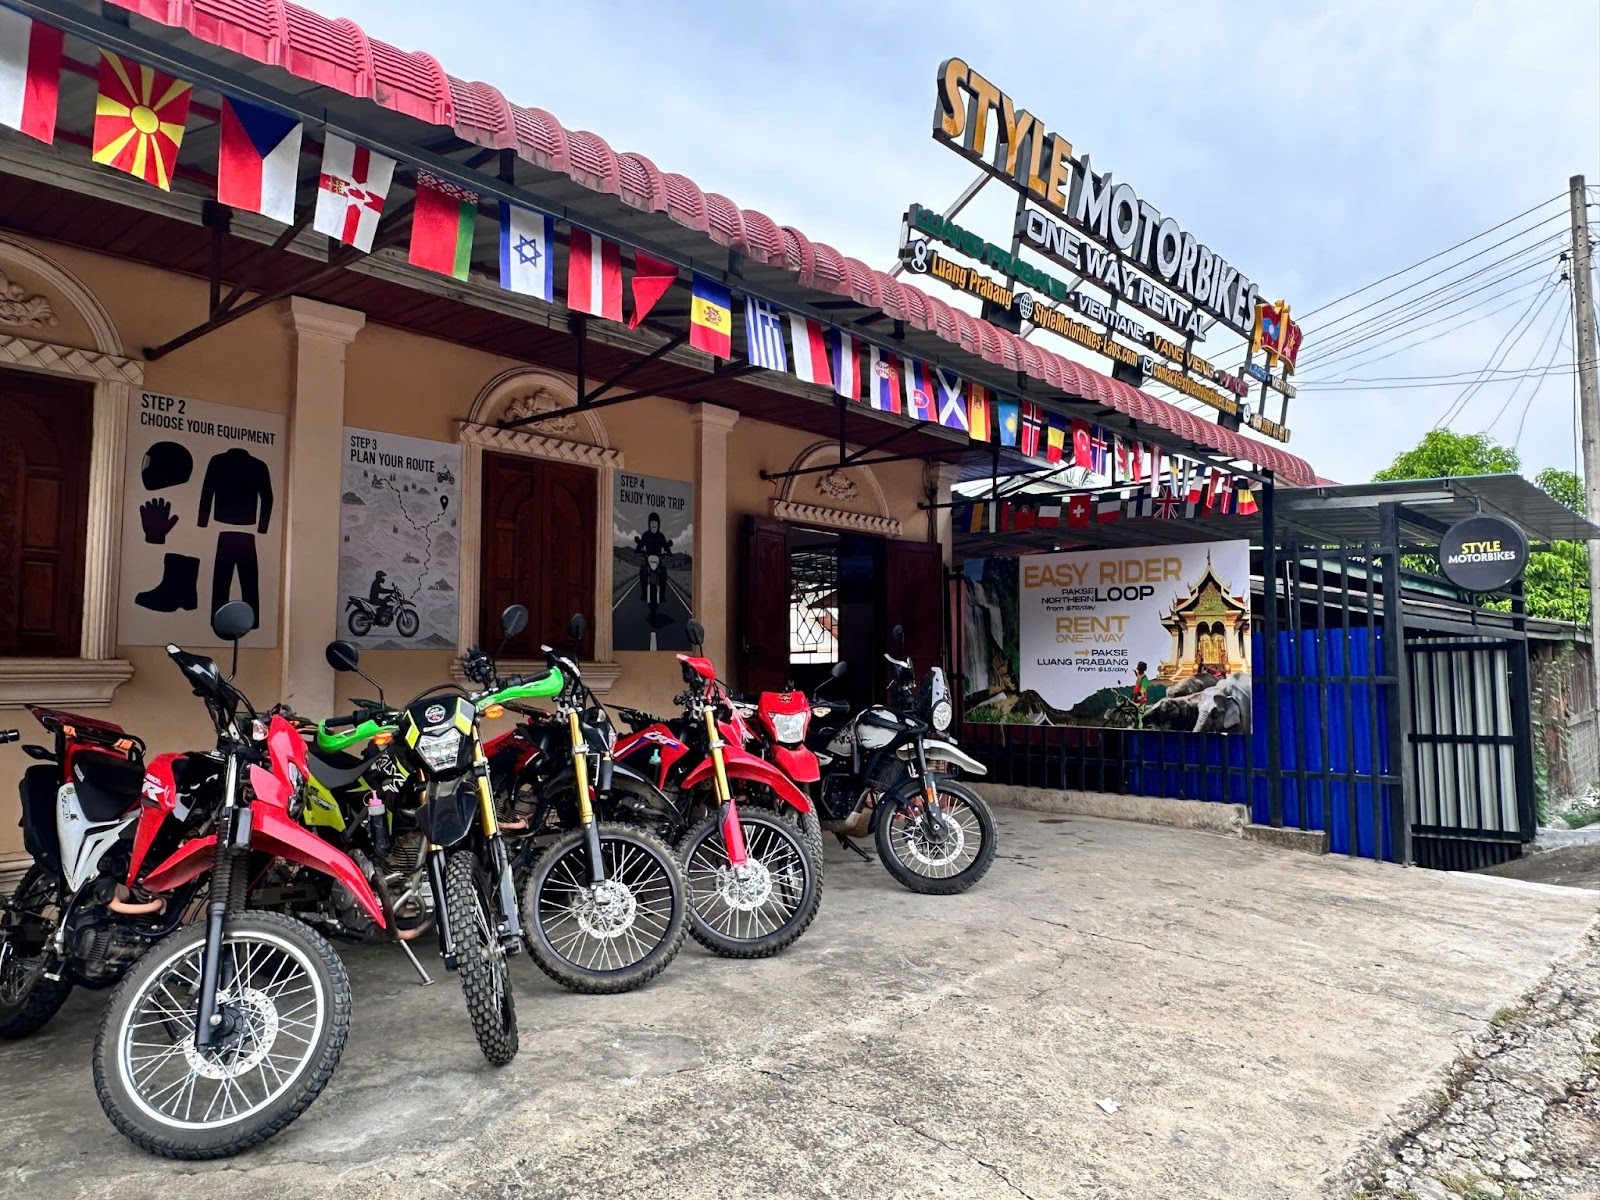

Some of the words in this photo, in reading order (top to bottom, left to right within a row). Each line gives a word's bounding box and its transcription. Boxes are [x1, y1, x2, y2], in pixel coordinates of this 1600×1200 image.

[936, 57, 1073, 211] STYLE
[1076, 157, 1258, 332] MOTORBIKES
[932, 252, 968, 290] Luang
[969, 270, 1013, 310] Prabang
[1026, 209, 1081, 265] ONE
[1086, 244, 1136, 300] WAY
[1139, 278, 1207, 341] RENTAL
[1079, 292, 1144, 340] VIENTIANE
[1153, 332, 1184, 363] VANG
[141, 393, 174, 412] STEP
[178, 400, 186, 414] 2
[141, 412, 184, 430] CHOOSE
[187, 419, 214, 435] YOUR
[217, 424, 275, 445] EQUIPMENT
[350, 435, 370, 449] STEP
[372, 439, 377, 450] 3
[350, 449, 376, 464] PLAN
[379, 453, 403, 468] YOUR
[406, 457, 435, 473] ROUTE
[620, 475, 638, 488] STEP
[640, 478, 645, 490] 4
[620, 489, 643, 505] ENJOY
[646, 493, 666, 508] YOUR
[667, 496, 685, 510] TRIP
[1461, 541, 1501, 554] STYLE
[1448, 551, 1516, 564] MOTORBIKES
[1024, 562, 1089, 588] EASY
[1100, 557, 1183, 585] RIDER
[1041, 596, 1095, 605] NORTHERN
[1094, 585, 1155, 602] LOOP
[1056, 615, 1130, 633] RENT
[1056, 633, 1124, 644] ONE-WAY
[1037, 658, 1072, 666] LUANG
[1075, 658, 1129, 666] PRABANG
[1091, 649, 1128, 657] PAKSE
